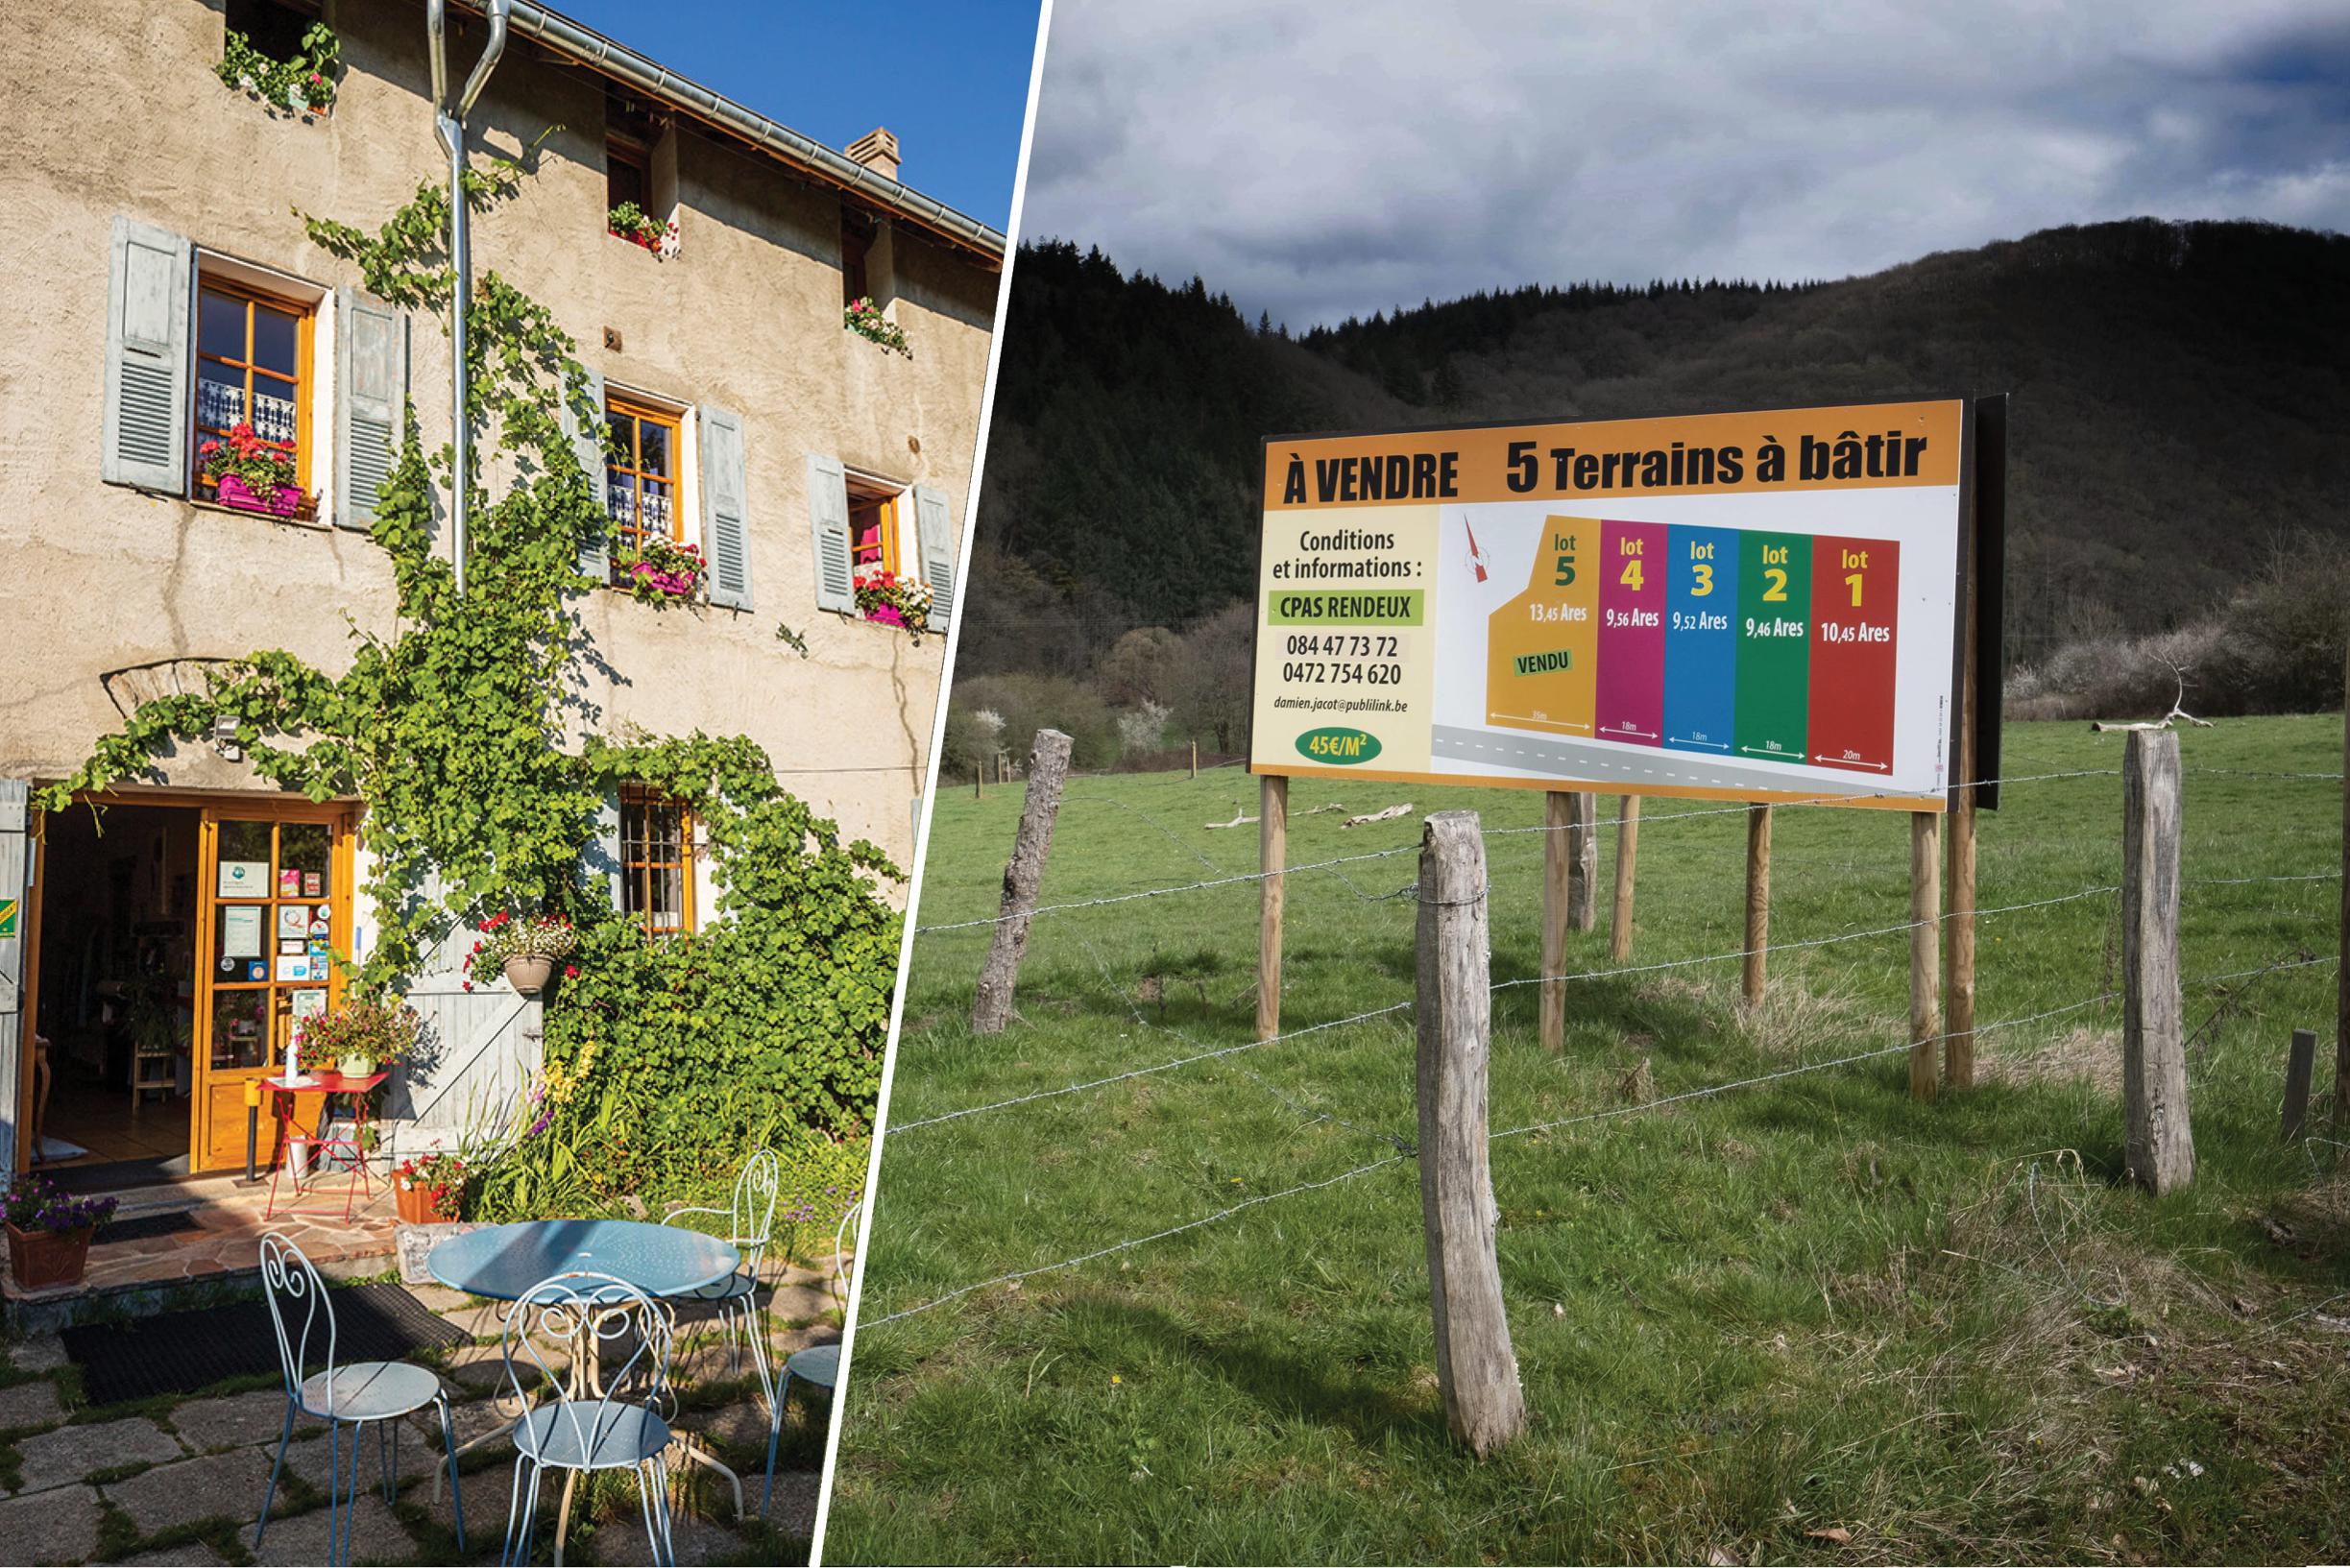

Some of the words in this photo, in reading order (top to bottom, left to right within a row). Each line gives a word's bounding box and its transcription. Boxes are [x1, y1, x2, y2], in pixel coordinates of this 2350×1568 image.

[1283, 453, 1307, 504] À
[1316, 451, 1459, 502] VENDRE
[1506, 441, 1538, 494] 5
[1550, 442, 1744, 491] Terrains
[1756, 435, 1785, 482] à
[1800, 430, 1927, 481] bâtir
[1299, 529, 1394, 551] Conditions
[1555, 534, 1576, 551] lot
[1620, 537, 1643, 556] lot
[1690, 541, 1714, 560] lot
[1762, 544, 1788, 565] lot
[1842, 549, 1868, 568] lot
[1272, 560, 1291, 579] et
[1295, 556, 1412, 579] informations
[1417, 562, 1422, 577] :
[1555, 556, 1576, 587] 5
[1620, 560, 1644, 591] 4
[1690, 564, 1713, 596] 3
[1762, 568, 1787, 601] 2
[1845, 573, 1862, 607] 1
[1280, 596, 1323, 618] CPAS
[1328, 596, 1411, 618] RENDEUX
[1529, 603, 1558, 623] 13,45
[1561, 603, 1587, 621] Ares
[1607, 608, 1629, 628] 9,56
[1632, 608, 1659, 626] Ares
[1673, 611, 1696, 631] 9,52
[1699, 611, 1728, 630] Ares
[1746, 617, 1771, 639] 9,46
[1773, 617, 1804, 637] Ares
[1821, 622, 1855, 644] 10,45
[1858, 622, 1890, 642] Ares
[1287, 635, 1319, 656] 084
[1322, 636, 1345, 656] 47
[1350, 636, 1370, 657] 73
[1377, 636, 1397, 658] 72
[1283, 662, 1325, 684] 0472
[1331, 663, 1363, 684] 754
[1368, 663, 1401, 685] 620
[1517, 651, 1568, 674] VENDU
[1273, 696, 1408, 713] damien.jacot@publilink.be
[1843, 749, 1860, 760] 20m
